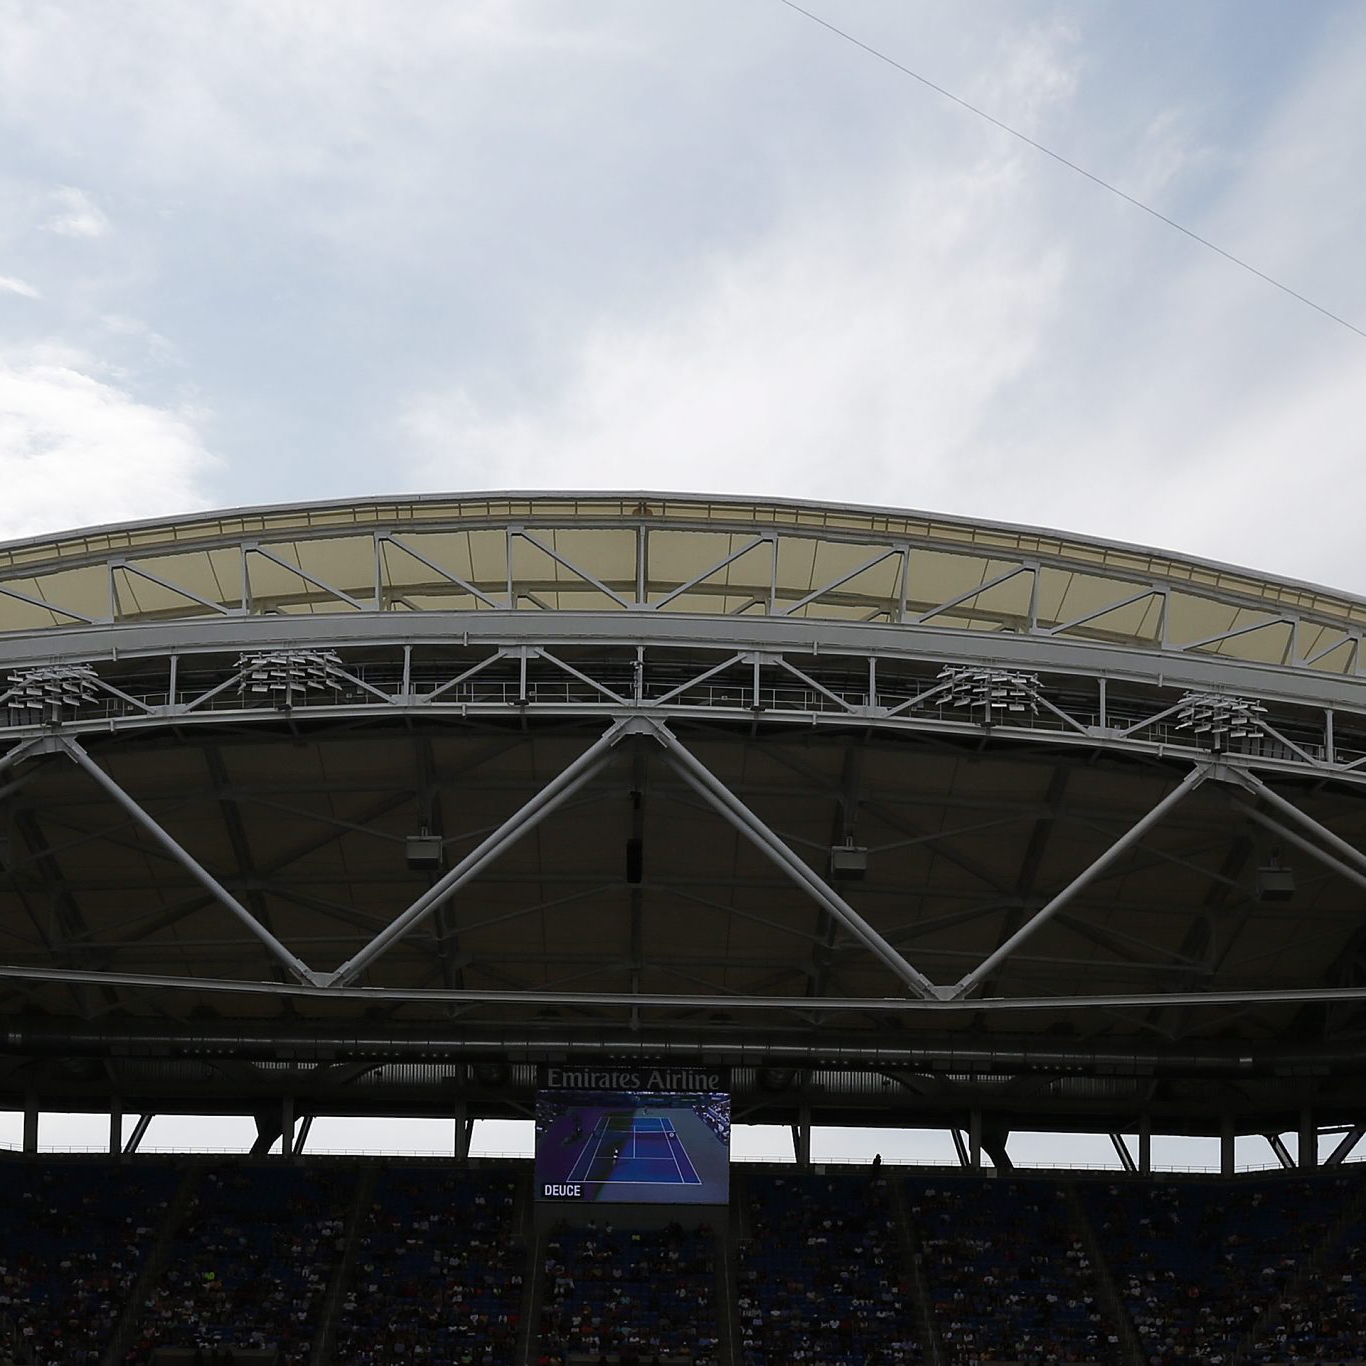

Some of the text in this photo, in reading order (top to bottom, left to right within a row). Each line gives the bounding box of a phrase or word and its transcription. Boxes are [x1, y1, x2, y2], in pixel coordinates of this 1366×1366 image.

[548, 1068, 720, 1090] Emirates Airline
[544, 1184, 581, 1197] DEUCE
